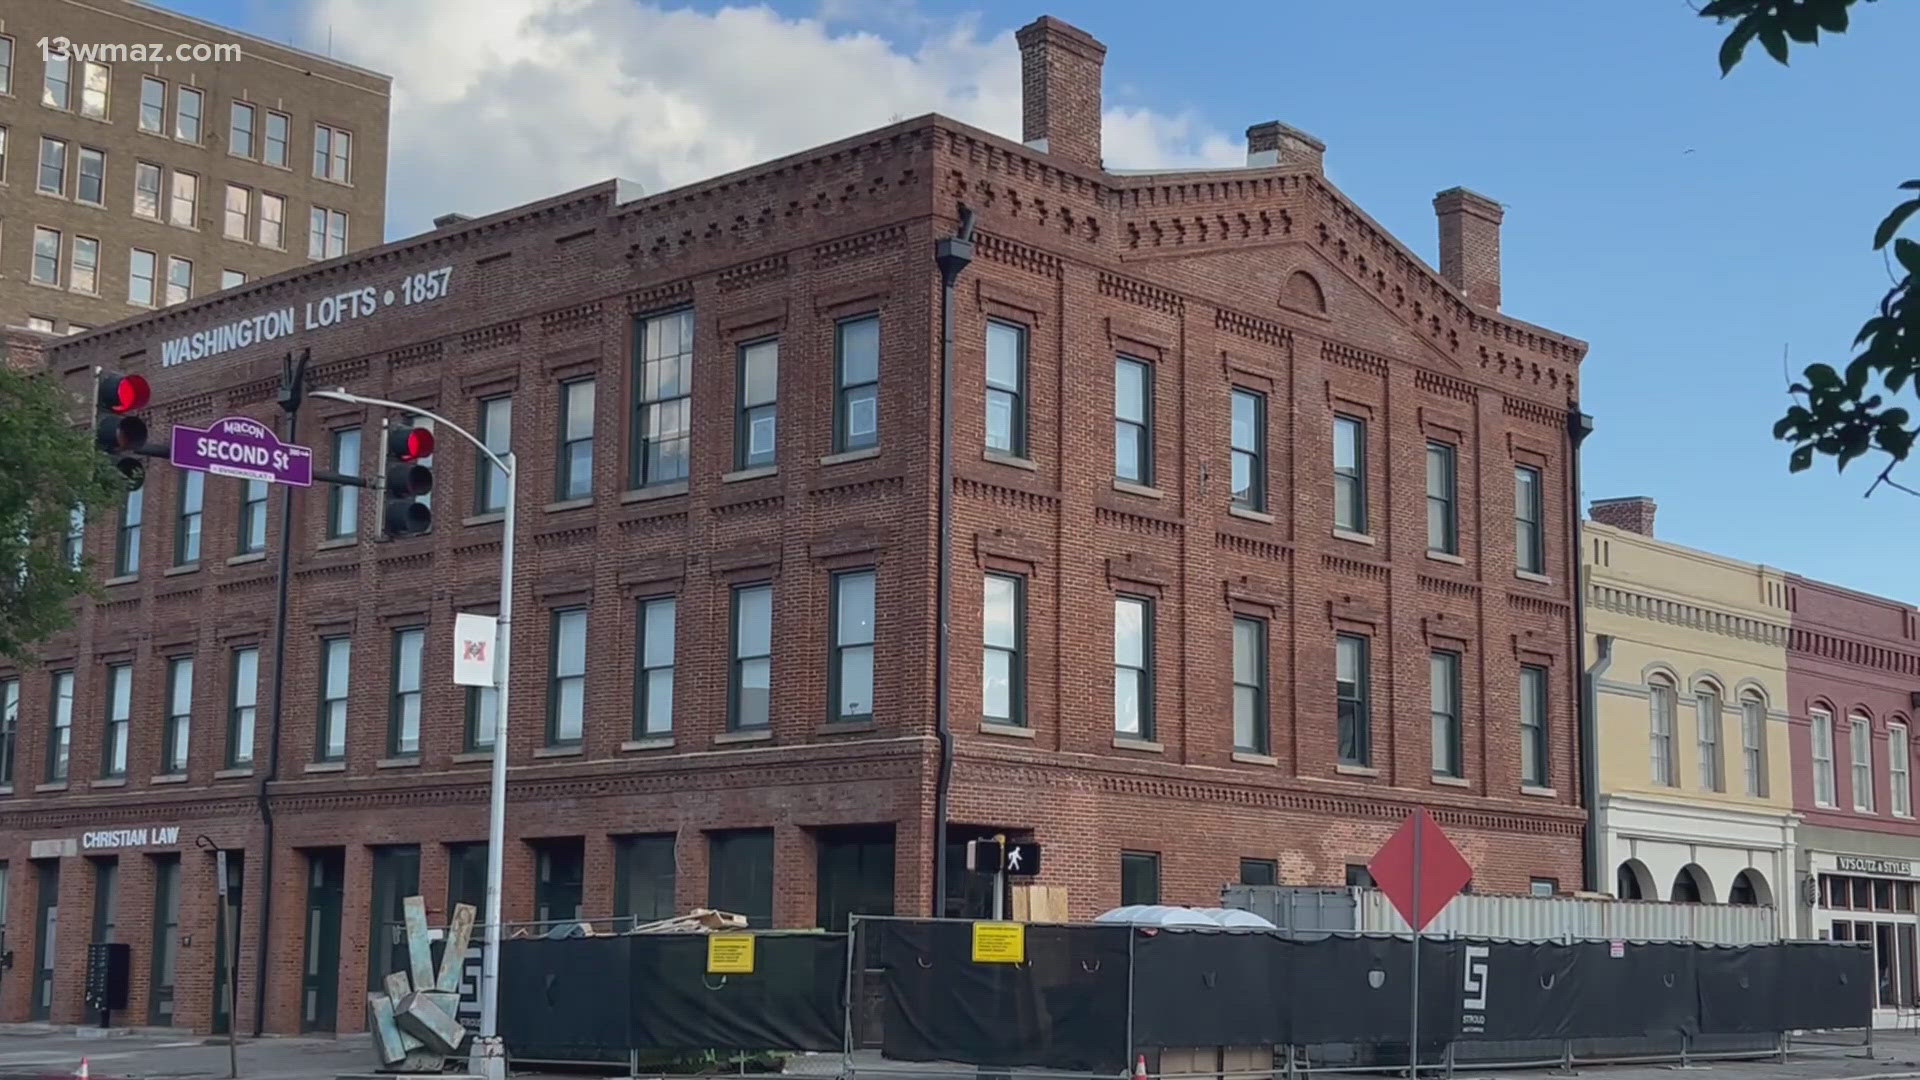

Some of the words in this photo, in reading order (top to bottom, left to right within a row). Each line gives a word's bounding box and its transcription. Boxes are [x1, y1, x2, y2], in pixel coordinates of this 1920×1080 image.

[161, 307, 294, 367] WASHINGTON
[305, 287, 376, 330] LOFTS
[401, 267, 452, 305] 1857
[197, 437, 269, 465] SECOND
[83, 828, 147, 848] CHRISTIAN
[152, 826, 180, 845] LAW
[1462, 1015, 1486, 1025] STROUD
